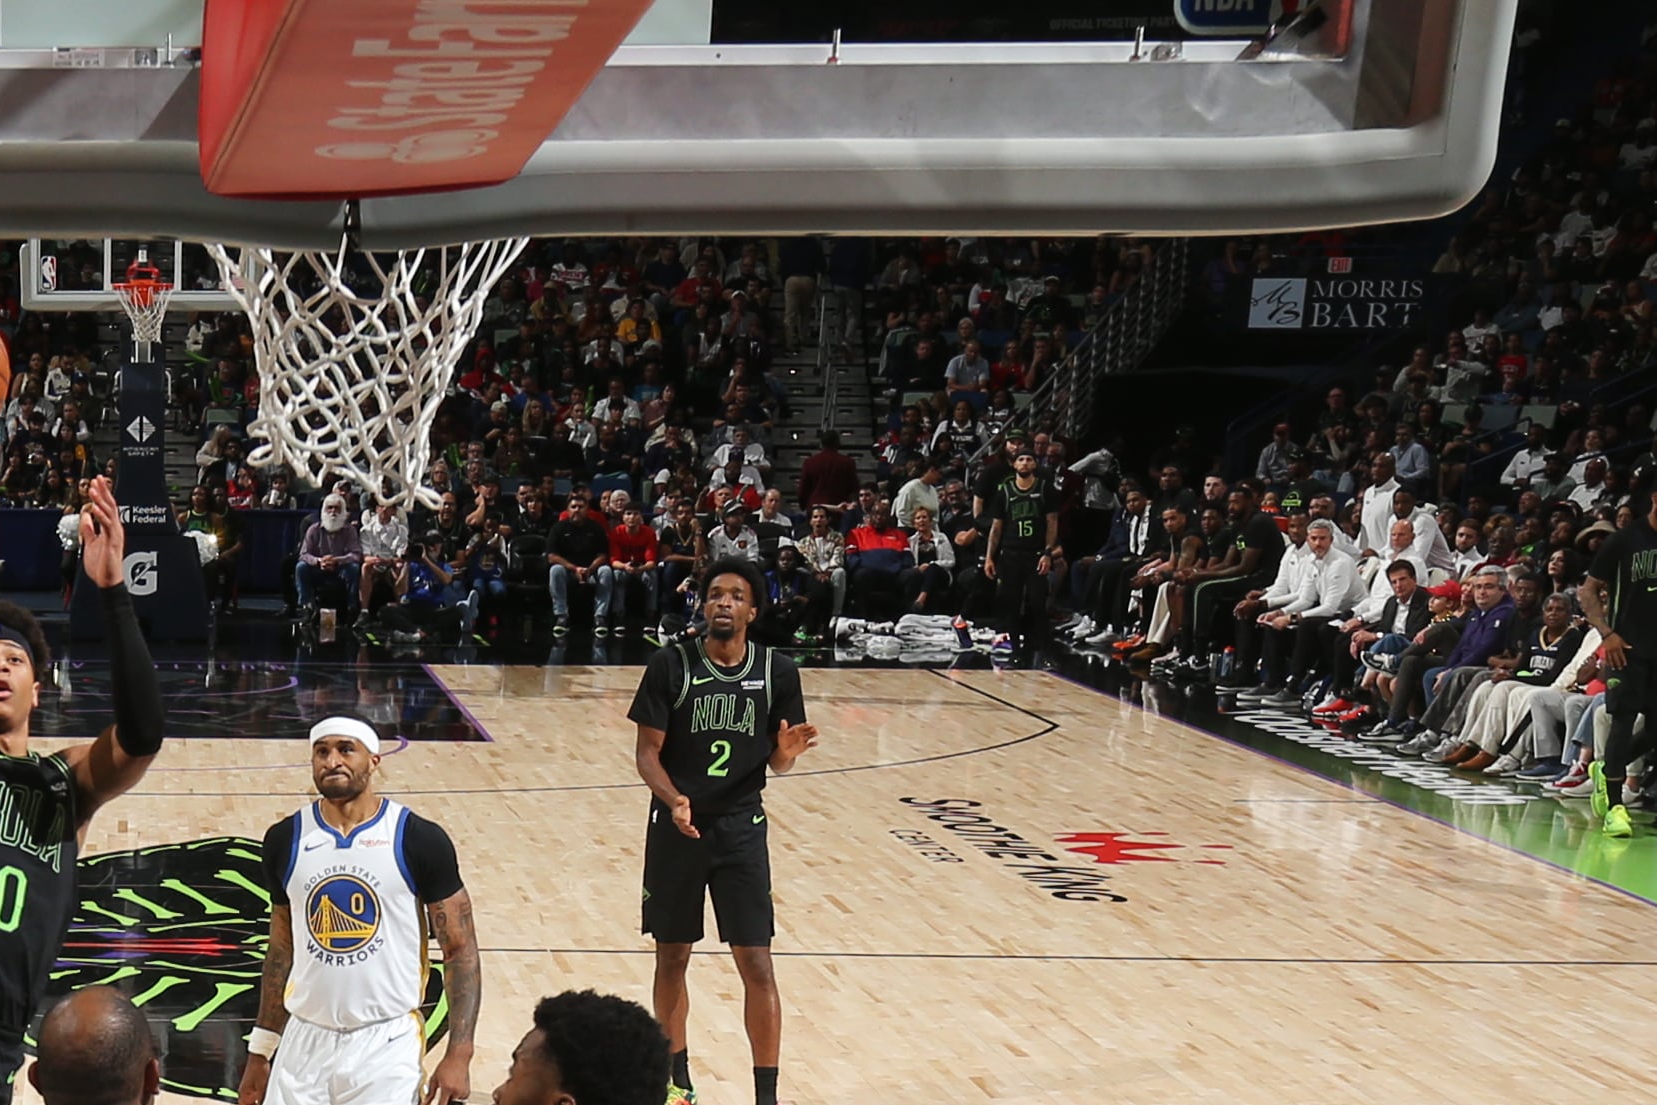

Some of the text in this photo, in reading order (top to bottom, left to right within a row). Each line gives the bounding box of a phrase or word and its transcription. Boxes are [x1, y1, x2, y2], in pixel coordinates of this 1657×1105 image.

[1312, 280, 1423, 298] MORRIS
[1309, 302, 1422, 328] BART
[132, 505, 167, 515] Keesler
[132, 514, 166, 524] Federal
[1018, 520, 1034, 537] 15
[123, 551, 158, 596] G
[691, 693, 755, 737] NOLA
[707, 740, 732, 777] 2
[898, 797, 1059, 862] SMOOTHIE
[889, 829, 965, 863] CENTER
[304, 864, 382, 892] GOLDEN STATE
[349, 892, 364, 915] 0
[305, 936, 385, 968] WARRIORS
